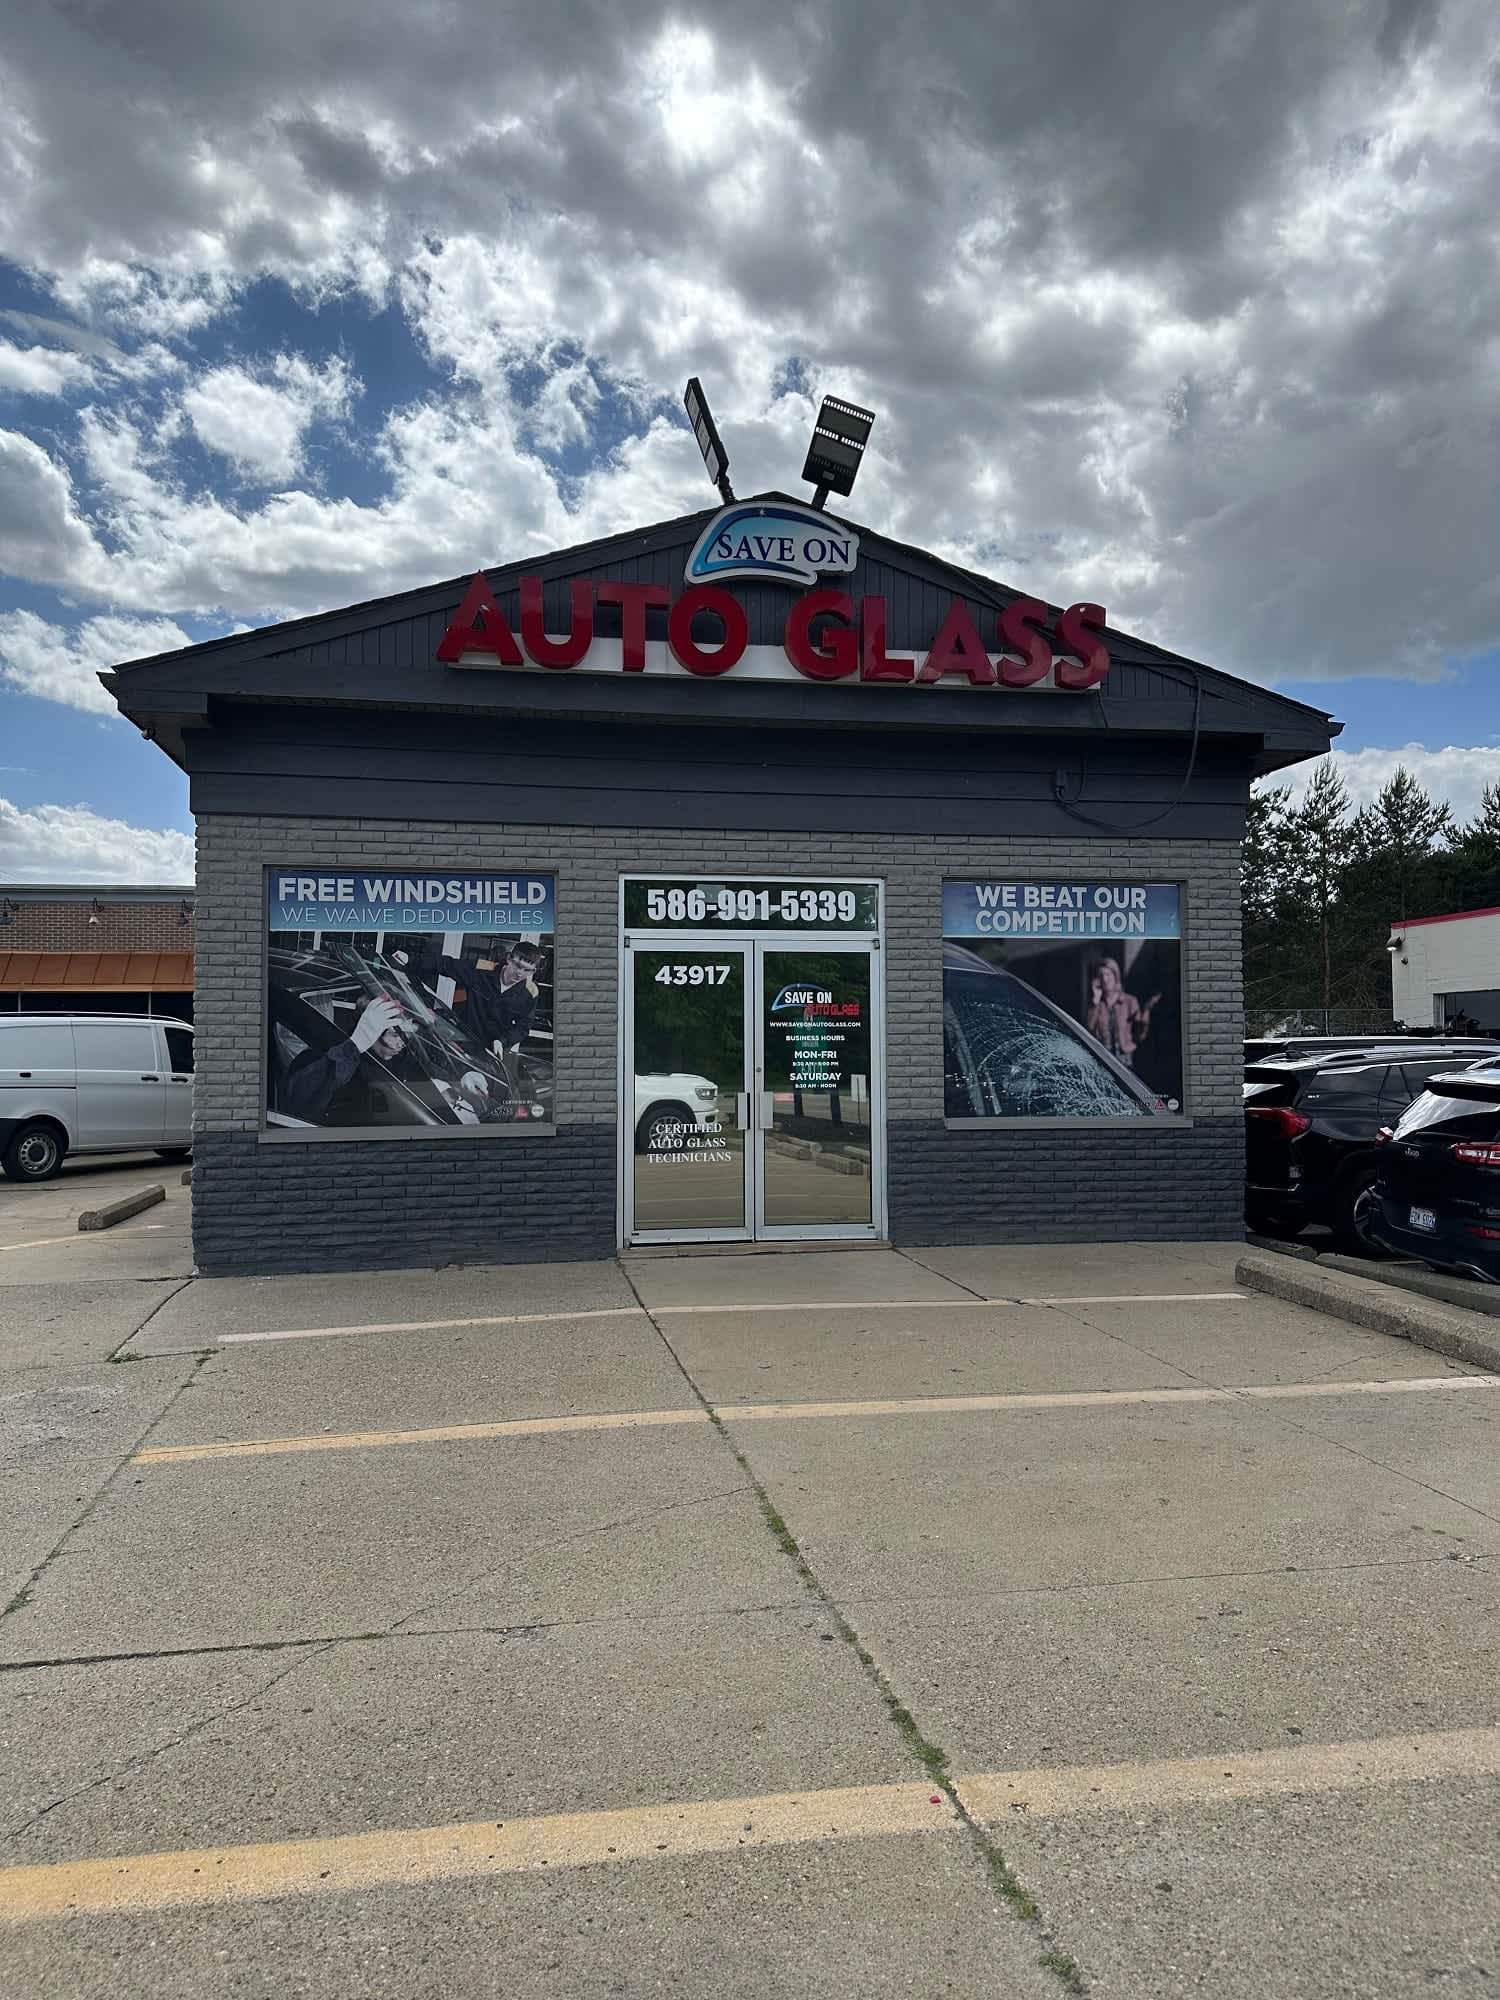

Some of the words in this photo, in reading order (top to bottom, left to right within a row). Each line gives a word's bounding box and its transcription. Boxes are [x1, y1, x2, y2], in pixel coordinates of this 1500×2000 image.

[717, 534, 795, 561] SAVE
[803, 538, 851, 564] ON
[436, 570, 748, 676] AUTO
[784, 591, 1110, 689] GLASS
[279, 877, 355, 902] FREE
[363, 879, 546, 905] WINDSHIELD
[975, 885, 1017, 907] WE
[1024, 886, 1087, 909] BEAT
[1094, 887, 1146, 909] OUR
[647, 889, 856, 922] 586-991-5339
[281, 906, 317, 923] WE
[324, 907, 395, 924] WAIVE
[402, 908, 544, 926] DEDUCTIBLES
[975, 911, 1145, 933] COMPETITION
[655, 965, 731, 985] 43917
[784, 991, 814, 1004] SAVE
[816, 991, 832, 1004] ON
[806, 1004, 830, 1016] AUTO
[831, 1004, 860, 1016] GLASS
[794, 1050, 837, 1059] MON-FRI
[789, 1072, 842, 1081] SATURDAY
[656, 1123, 723, 1134] CERTIFIED
[648, 1139, 683, 1149] AUTO
[687, 1137, 726, 1148] GLASS
[647, 1151, 732, 1163] TECHNICIANS
